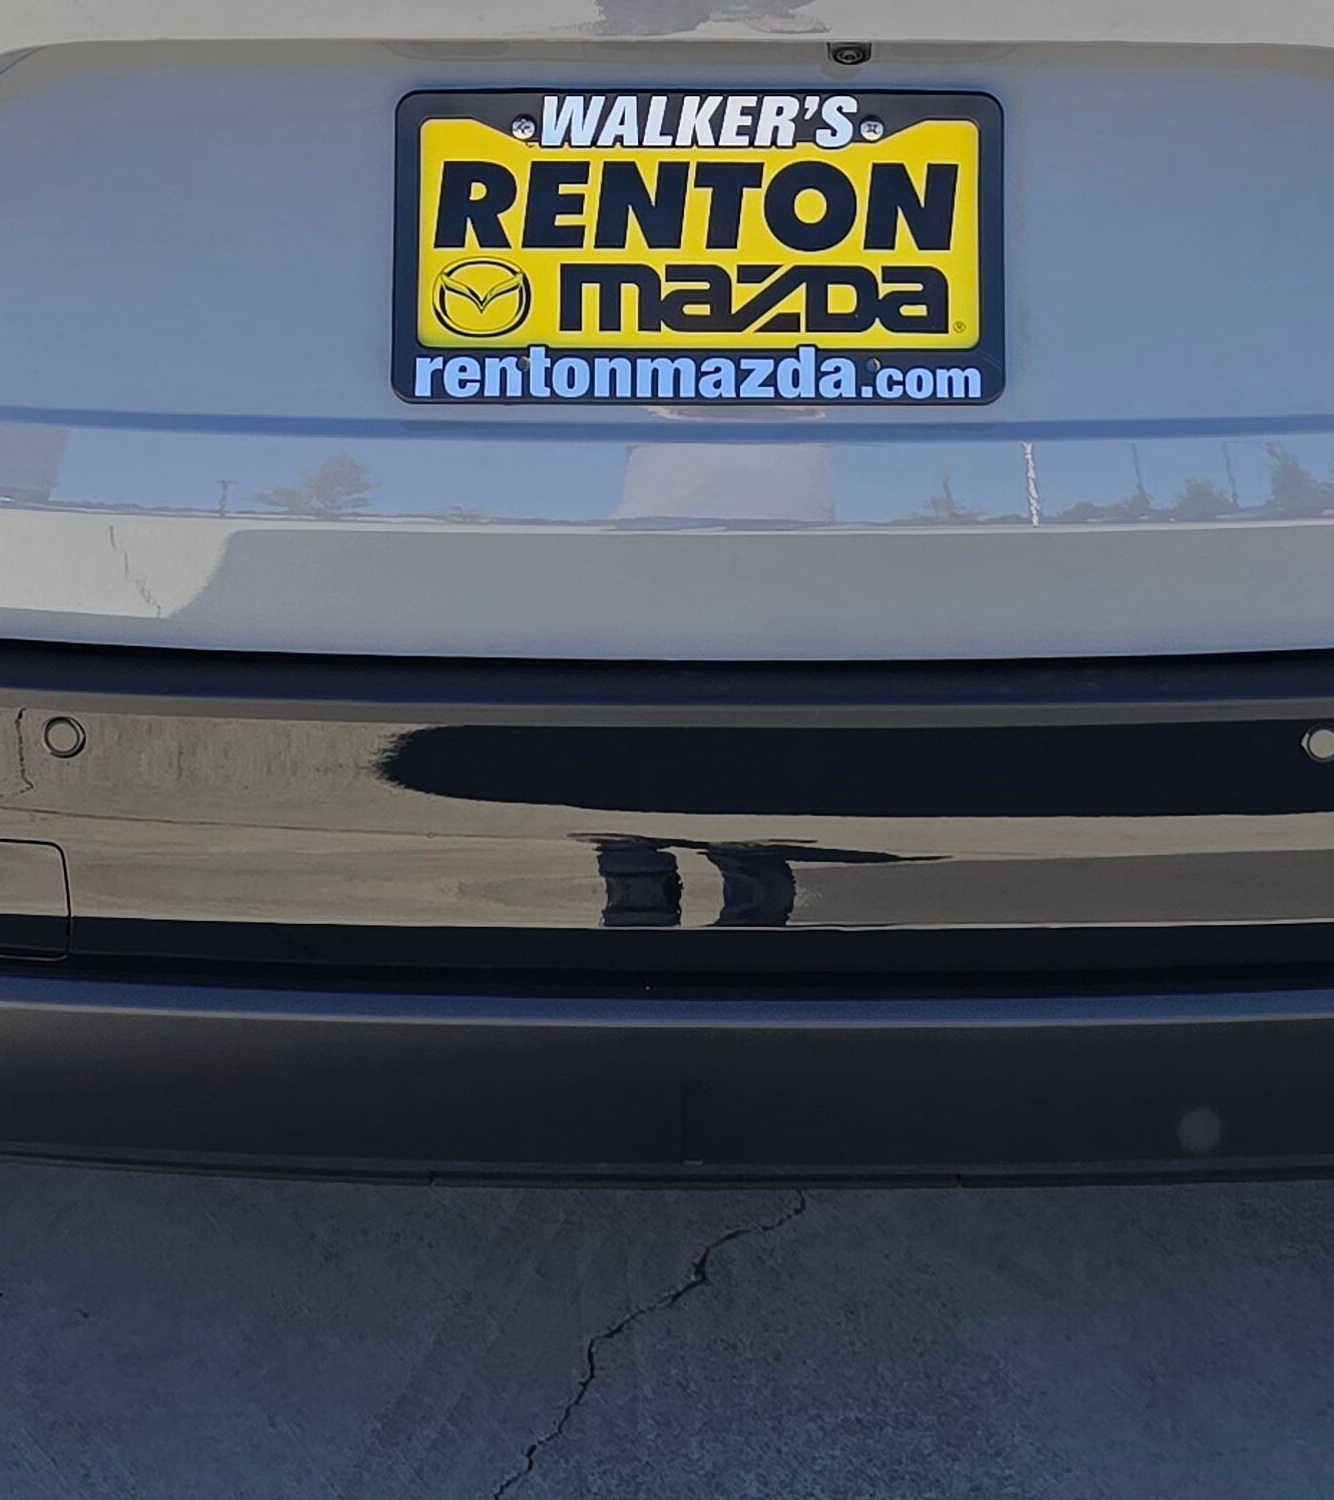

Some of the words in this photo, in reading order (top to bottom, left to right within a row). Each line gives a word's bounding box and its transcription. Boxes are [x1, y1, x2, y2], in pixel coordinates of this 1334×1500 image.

[539, 94, 858, 148] WALKER'S
[432, 160, 959, 252] RENTON
[558, 262, 951, 335] mazda
[413, 345, 983, 400] rentonmazda.com
